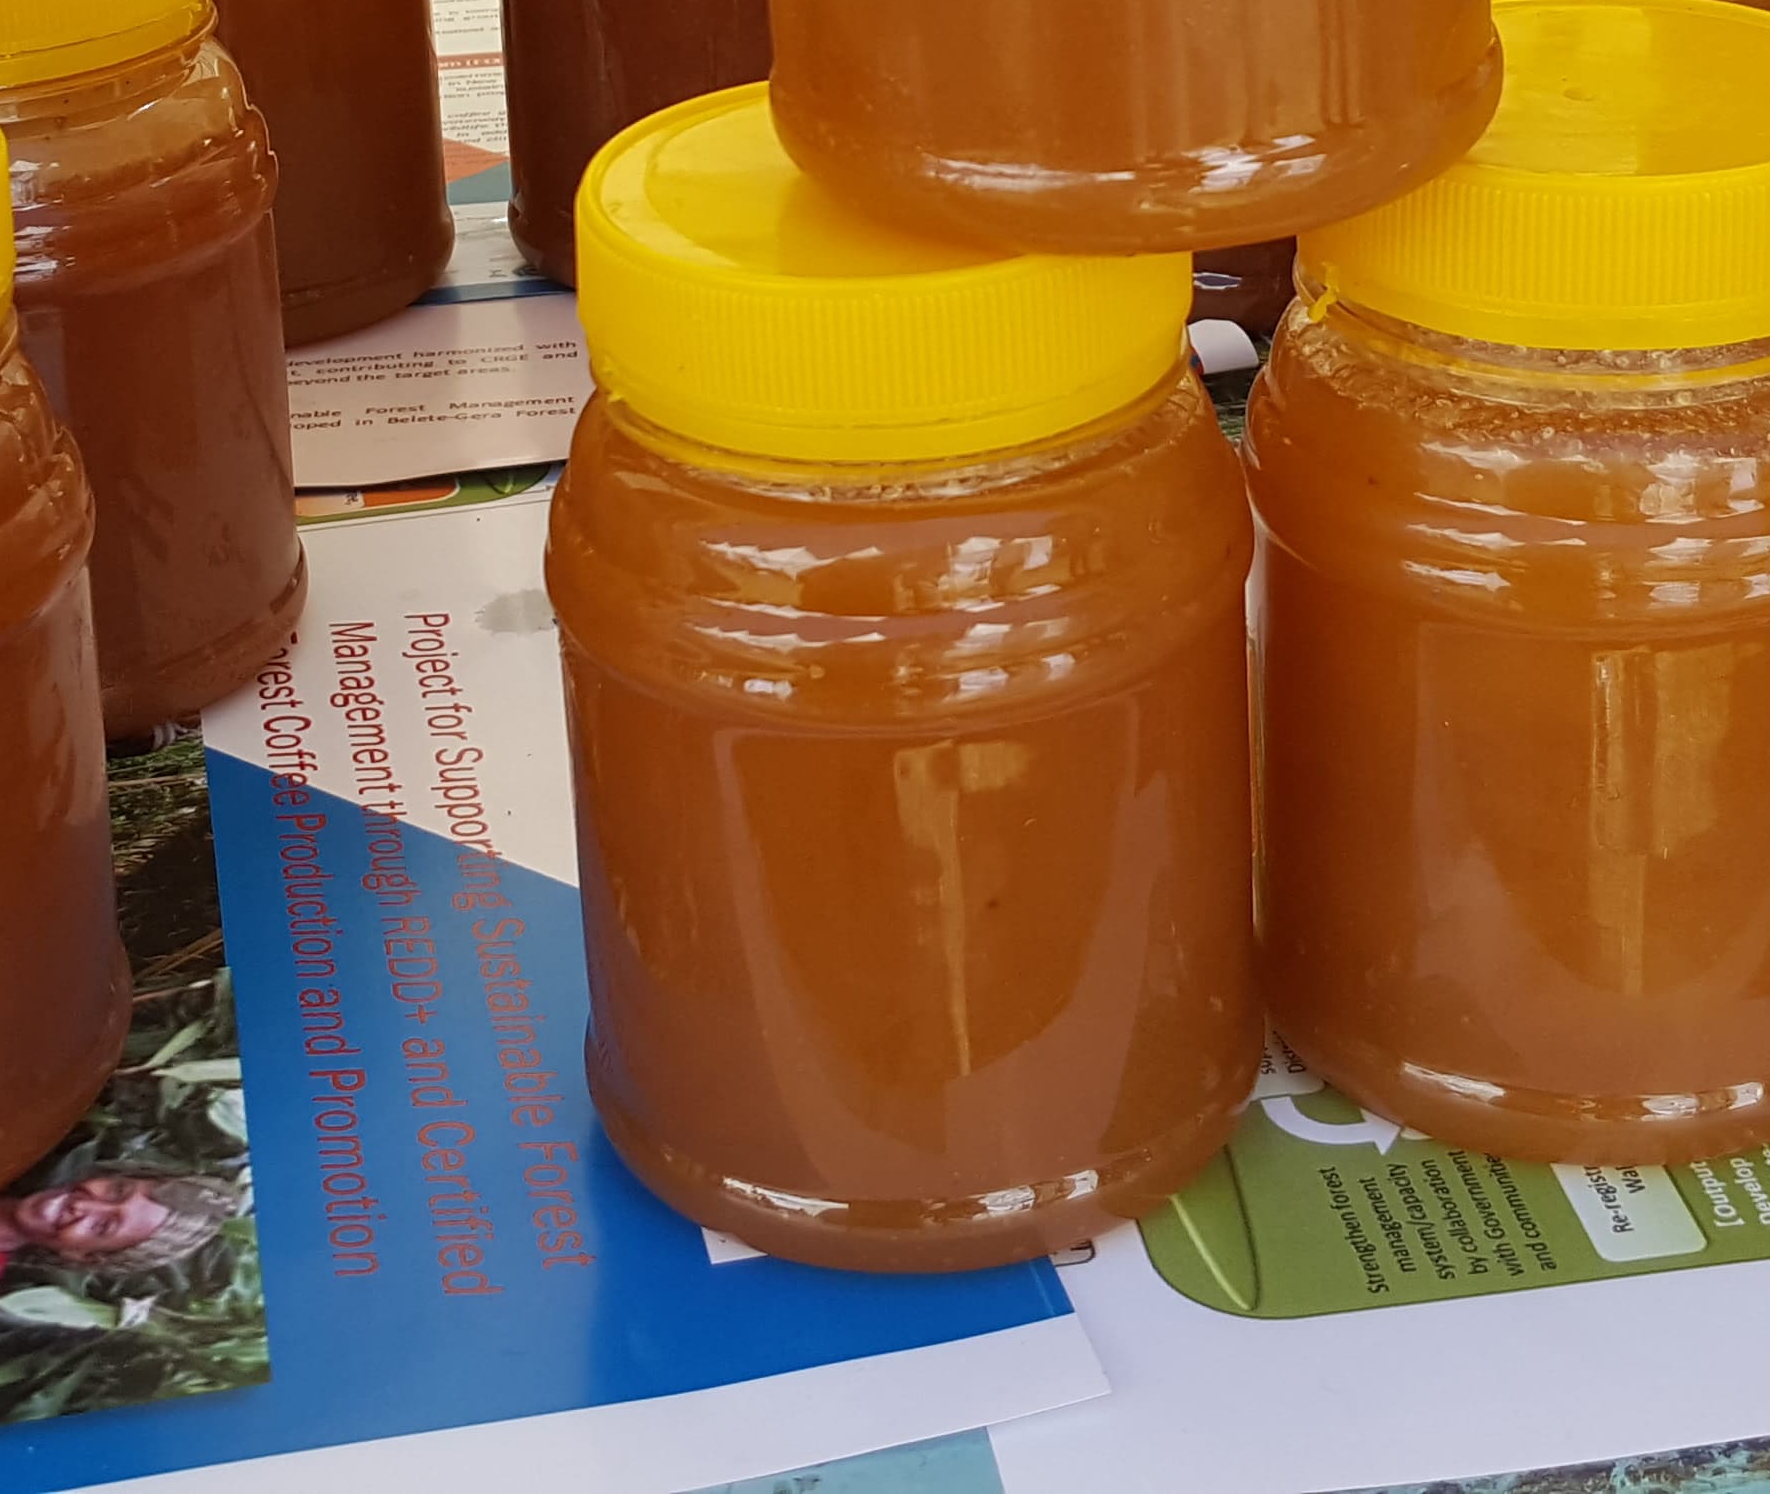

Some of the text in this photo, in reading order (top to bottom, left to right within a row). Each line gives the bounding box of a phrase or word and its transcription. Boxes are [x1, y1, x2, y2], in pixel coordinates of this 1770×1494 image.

[316, 361, 434, 375] contributing
[542, 350, 578, 360] and
[356, 373, 387, 381] the
[395, 368, 450, 379] target
[413, 344, 524, 358] harmonized
[536, 341, 577, 350] with
[355, 418, 374, 426] in
[387, 412, 502, 424] Belete-Gera
[516, 407, 576, 417] Forest
[365, 404, 425, 414] Forest
[449, 396, 574, 409] Management
[263, 715, 319, 807] Coffee
[275, 813, 344, 978] Production
[402, 612, 597, 1270] Project for Supporting Sustainable Forest
[329, 621, 506, 1297] Management through REDD+ and Certified
[296, 985, 363, 1057] and
[309, 1068, 388, 1278] Promotion
[1388, 1161, 1456, 1281] system/capacity
[1420, 1159, 1489, 1277] by collaboration
[1448, 1149, 1526, 1277] with Government
[1320, 1166, 1390, 1294] Strengthen forest
[1359, 1176, 1417, 1274] management
[1526, 1241, 1558, 1272] and
